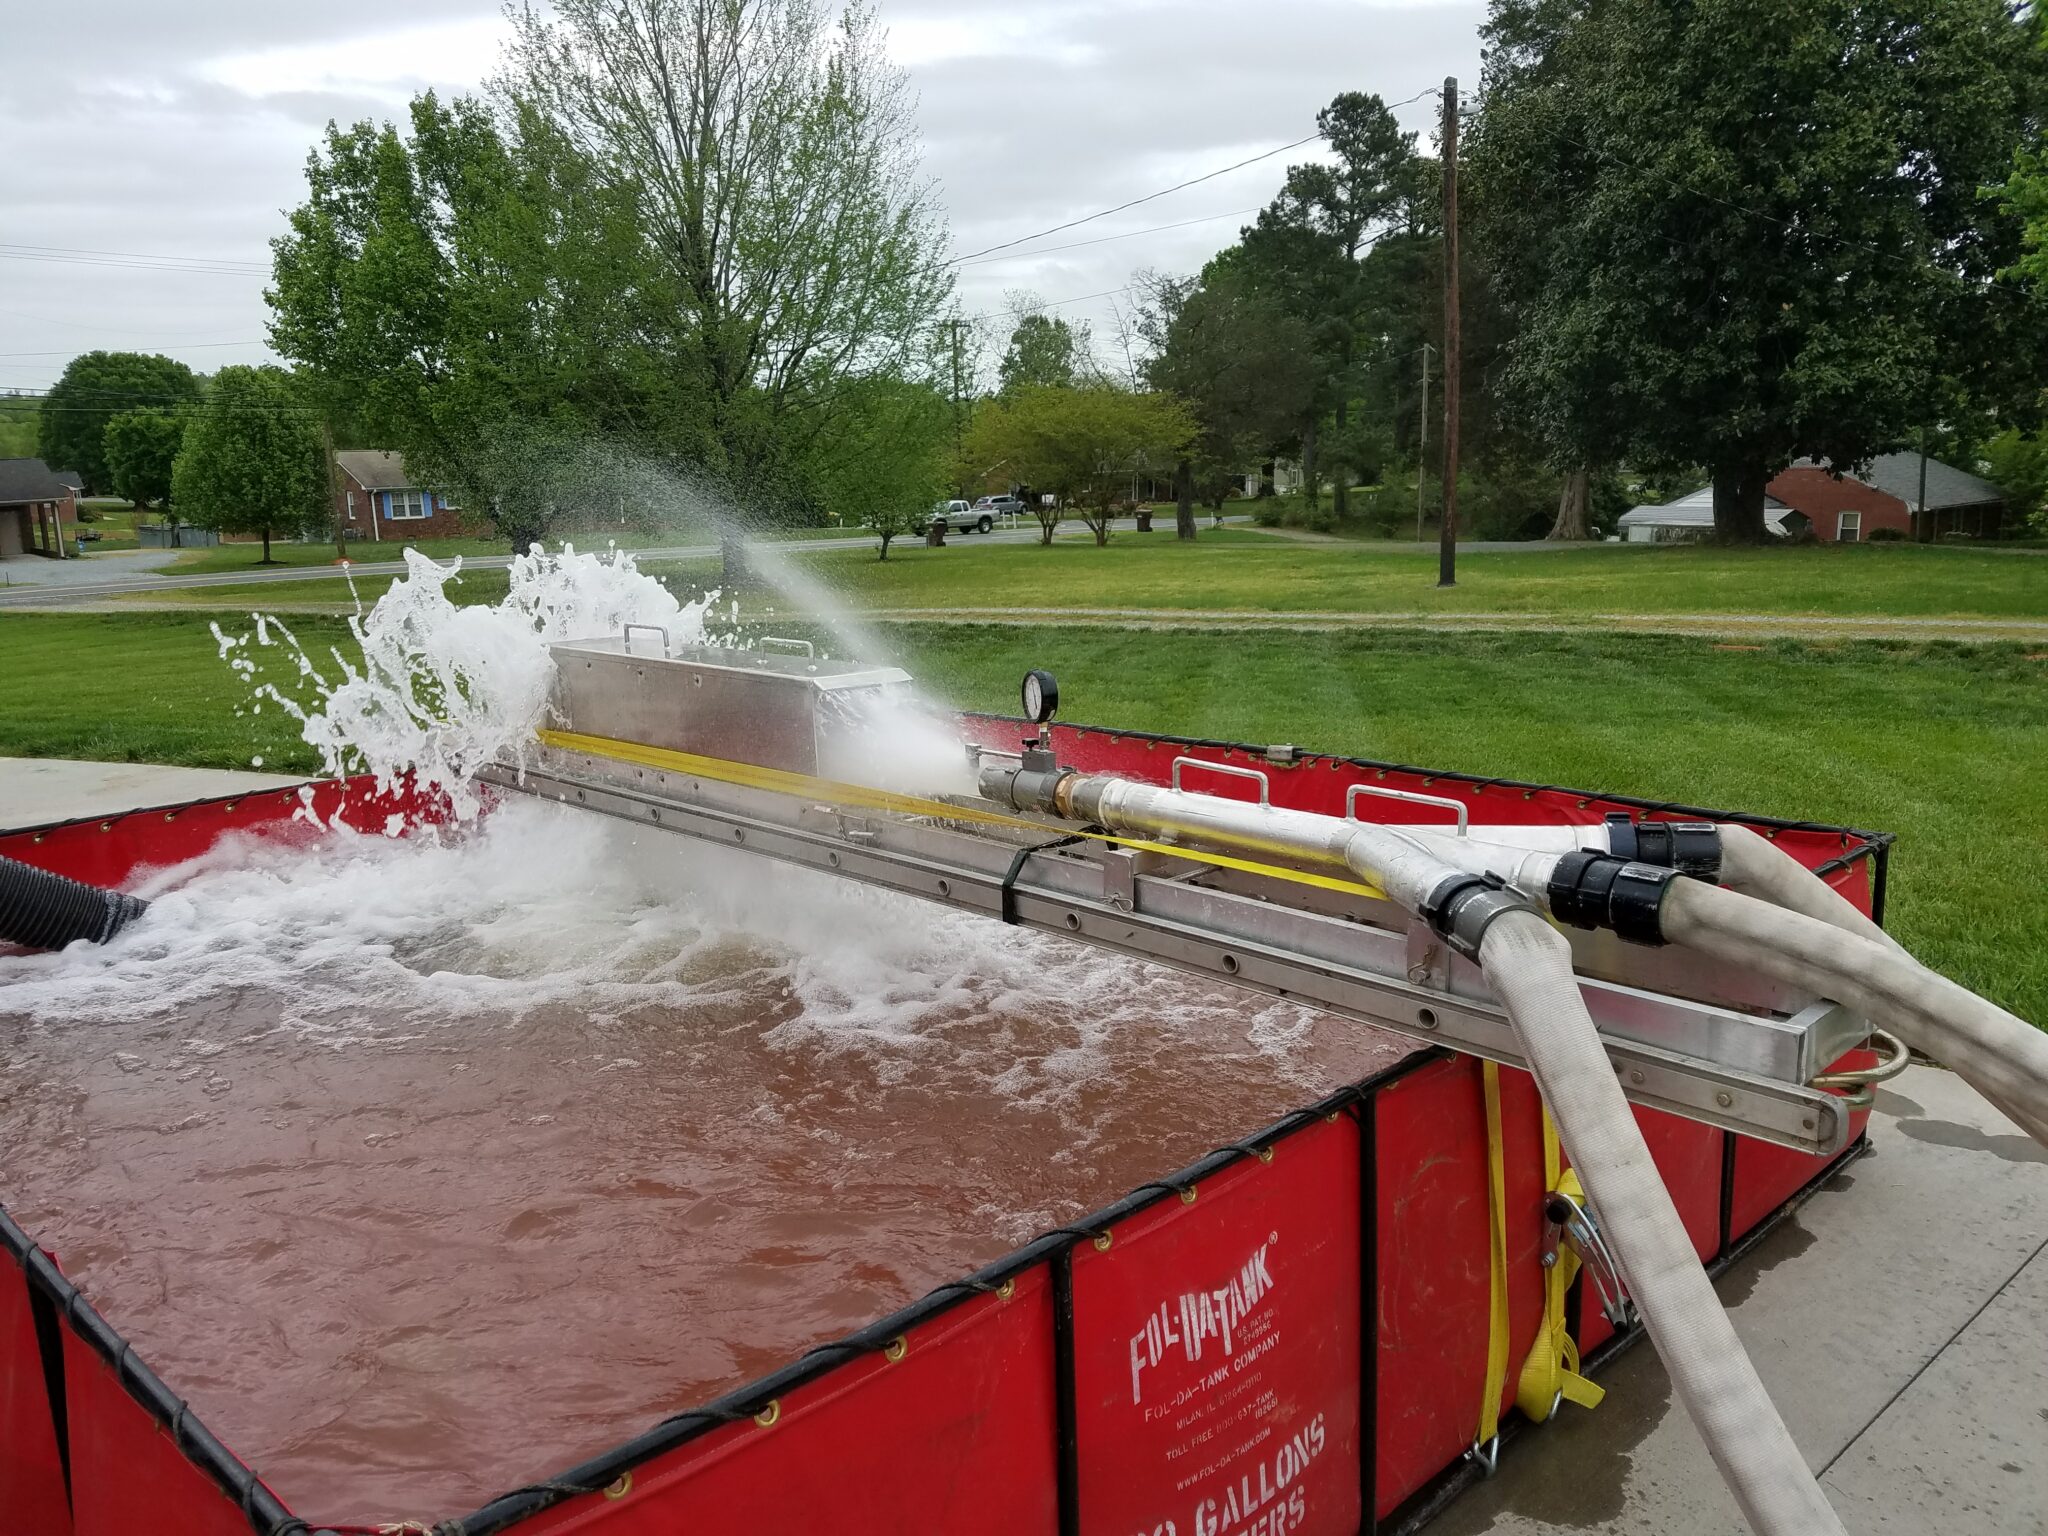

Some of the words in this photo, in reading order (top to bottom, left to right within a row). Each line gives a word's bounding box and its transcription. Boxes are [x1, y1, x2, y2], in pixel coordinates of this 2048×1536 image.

[1144, 1364, 1230, 1423] FOL-DA-TANK
[1234, 1330, 1281, 1373] COMPANY
[1165, 1444, 1189, 1461] TOLL
[1191, 1428, 1214, 1448] FREE
[1176, 1426, 1271, 1491] WWW.FOL-DA-TANK.COM
[1195, 1412, 1325, 1536] GALLONS
